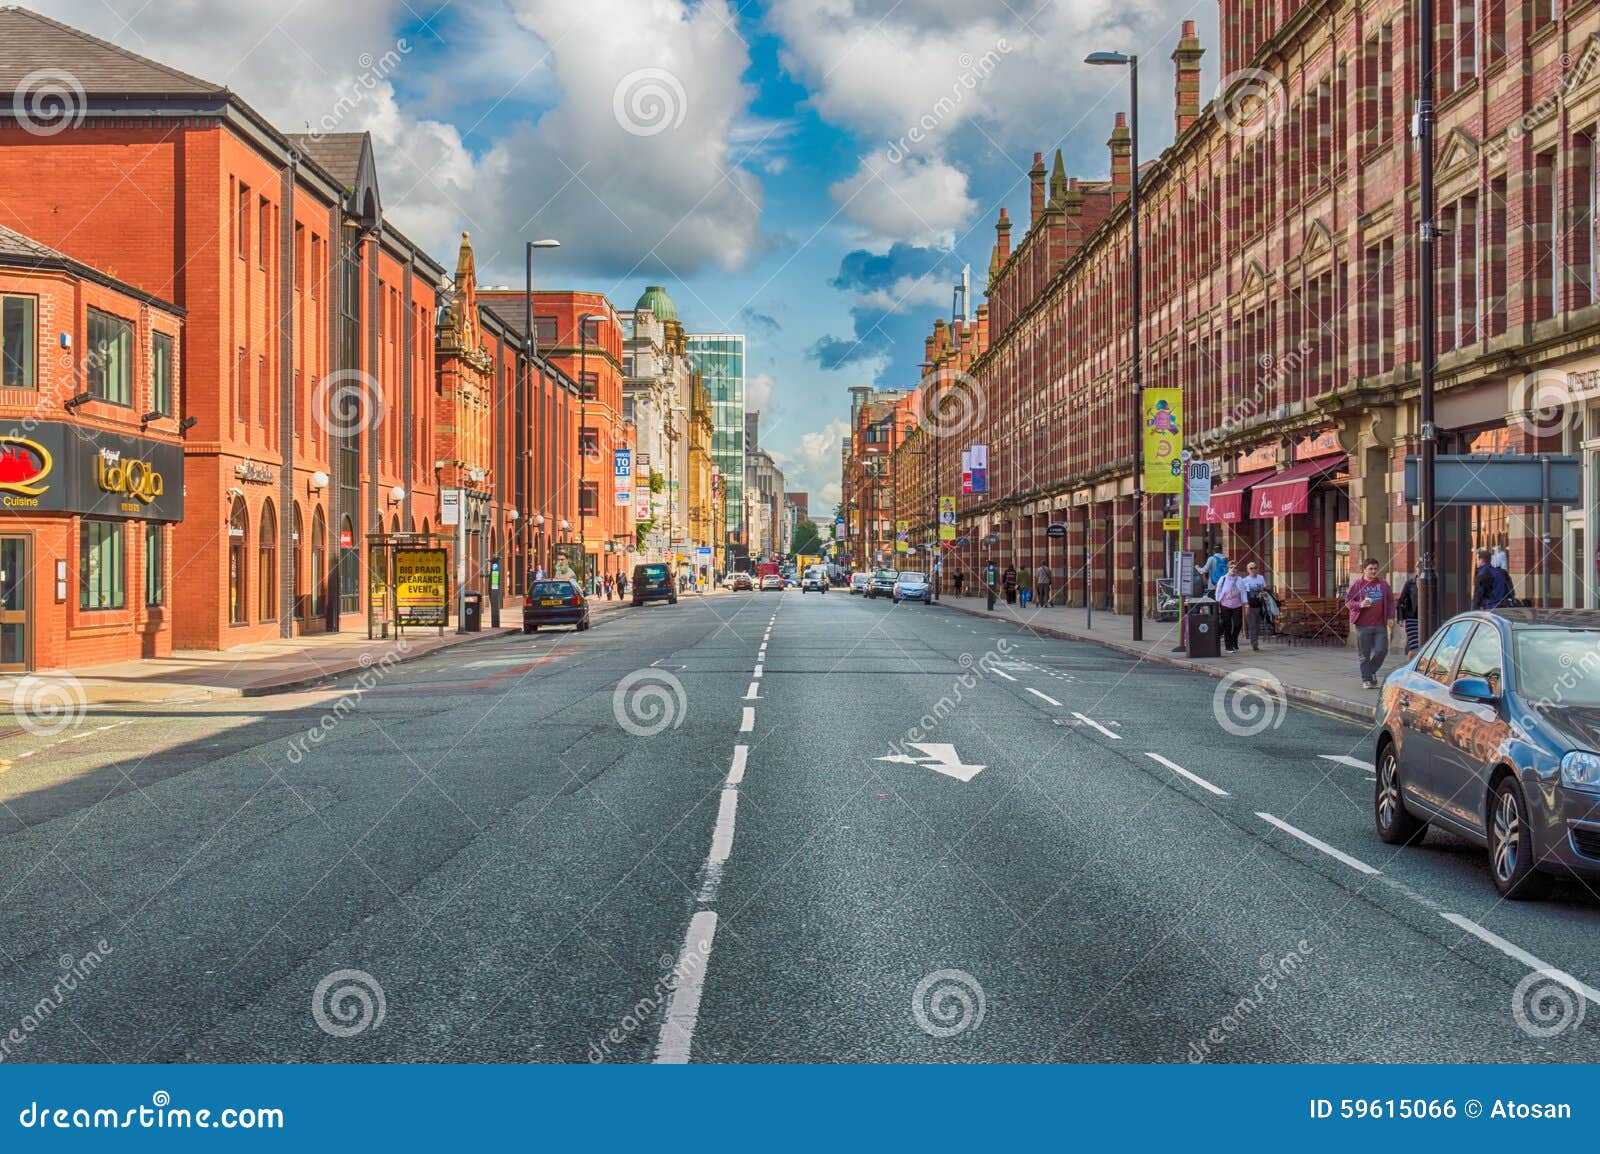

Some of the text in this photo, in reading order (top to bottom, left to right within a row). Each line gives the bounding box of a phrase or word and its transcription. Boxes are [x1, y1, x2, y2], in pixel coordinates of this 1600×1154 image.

[616, 458, 629, 467] TO
[615, 467, 630, 475] LET
[3, 496, 38, 507] Cuisine
[399, 566, 441, 574] BIG BRAND
[398, 575, 443, 583] CLEARANCE
